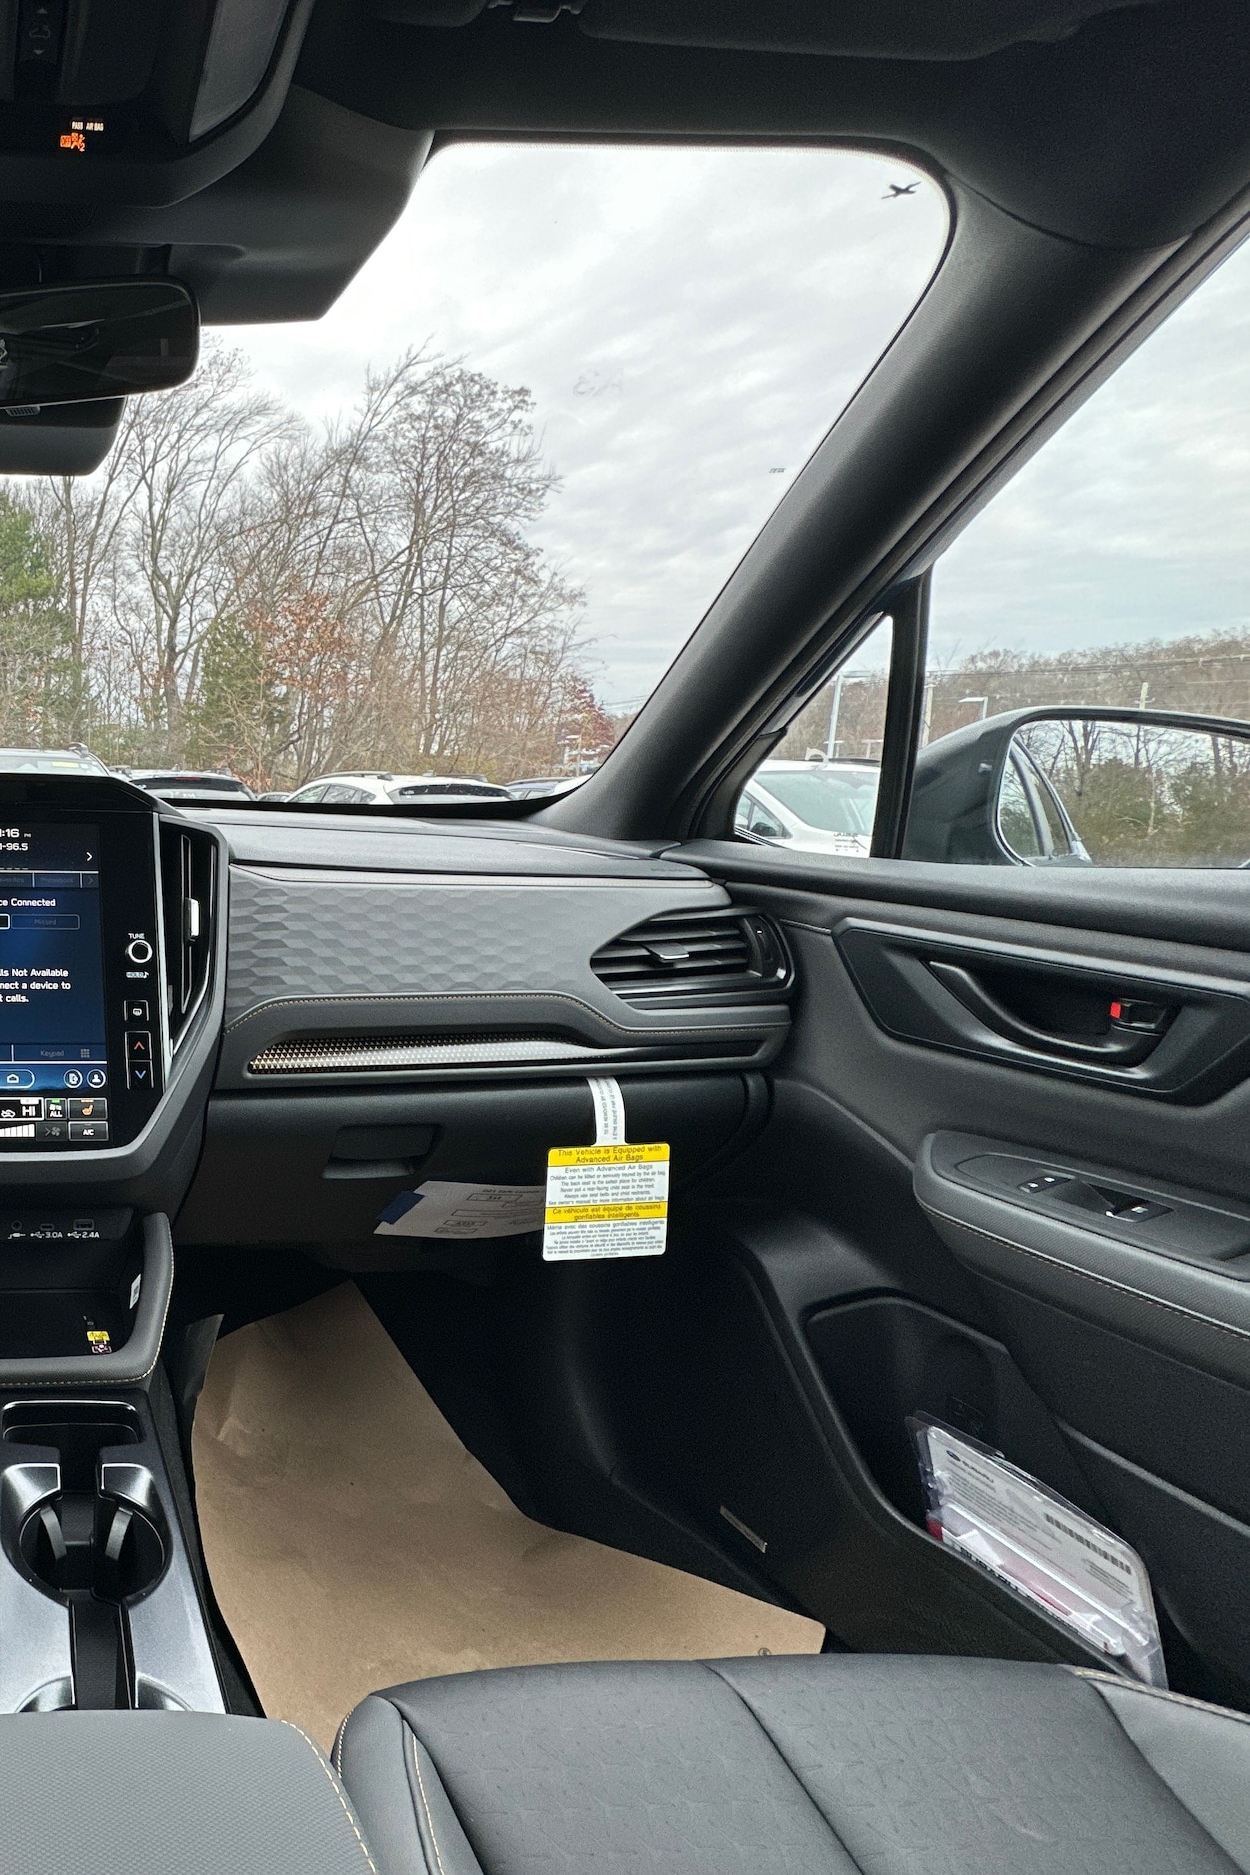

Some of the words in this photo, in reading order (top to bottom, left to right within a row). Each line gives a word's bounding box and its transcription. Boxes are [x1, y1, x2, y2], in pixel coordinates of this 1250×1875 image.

[72, 121, 83, 130] PASS
[86, 122, 94, 131] AIR
[94, 122, 104, 132] BAG
[11, 898, 56, 907] Connected
[11, 968, 28, 977] Not
[30, 968, 69, 978] Available
[30, 981, 59, 990] device
[60, 981, 71, 990] to
[5, 993, 29, 1003] calls.
[40, 1049, 65, 1059] Keypad
[22, 1105, 36, 1117] HI
[50, 1109, 63, 1118] ALL
[82, 1129, 94, 1137] A/C
[575, 1147, 601, 1155] Vehicle
[612, 1145, 645, 1155] Equipped
[575, 1155, 610, 1163] Advanced
[625, 1153, 643, 1162] Bags
[638, 1163, 653, 1171] Bags
